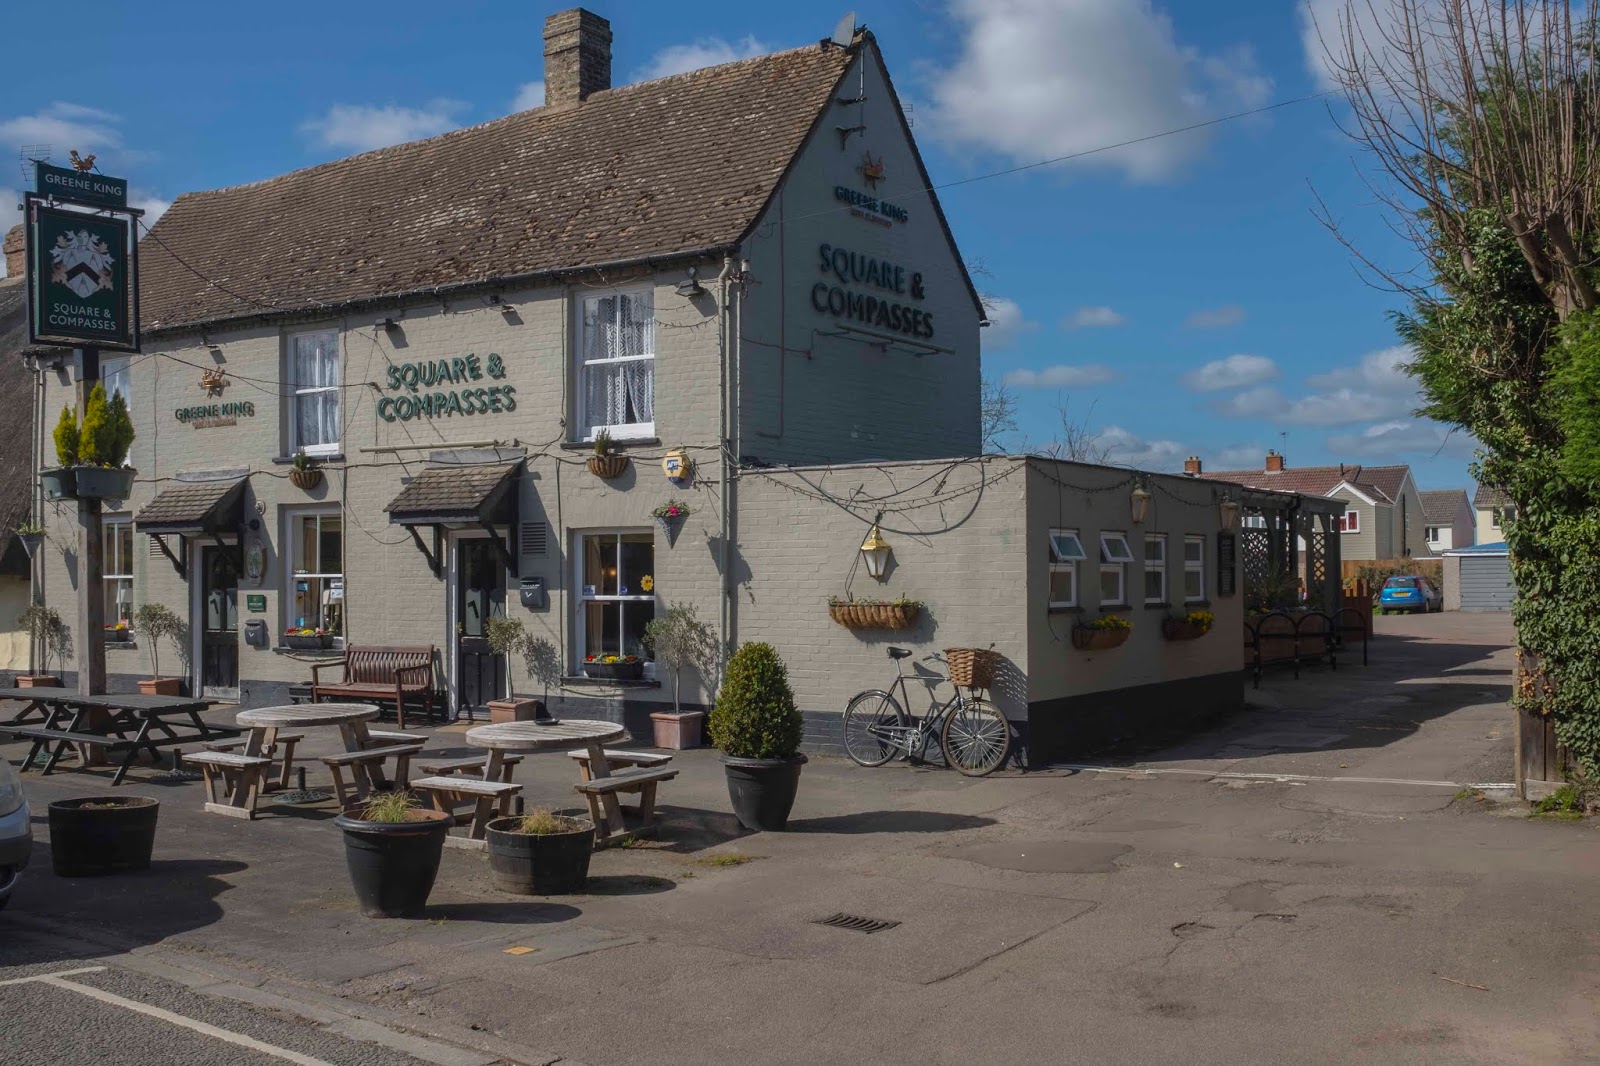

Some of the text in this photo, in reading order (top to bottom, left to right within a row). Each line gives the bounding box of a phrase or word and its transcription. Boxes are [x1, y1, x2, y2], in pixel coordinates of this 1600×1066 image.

[45, 173, 90, 190] GREENE
[94, 182, 122, 196] KING
[835, 186, 879, 213] GREENE
[881, 201, 908, 223] KING
[820, 243, 925, 300] SQUARE &
[49, 314, 116, 331] COMPASSES
[53, 302, 111, 318] SQUARE &
[811, 282, 934, 338] COMPASSES
[387, 352, 506, 391] SQUARE &
[175, 401, 254, 422] GREENE KING
[377, 384, 517, 422] COMPASSES
